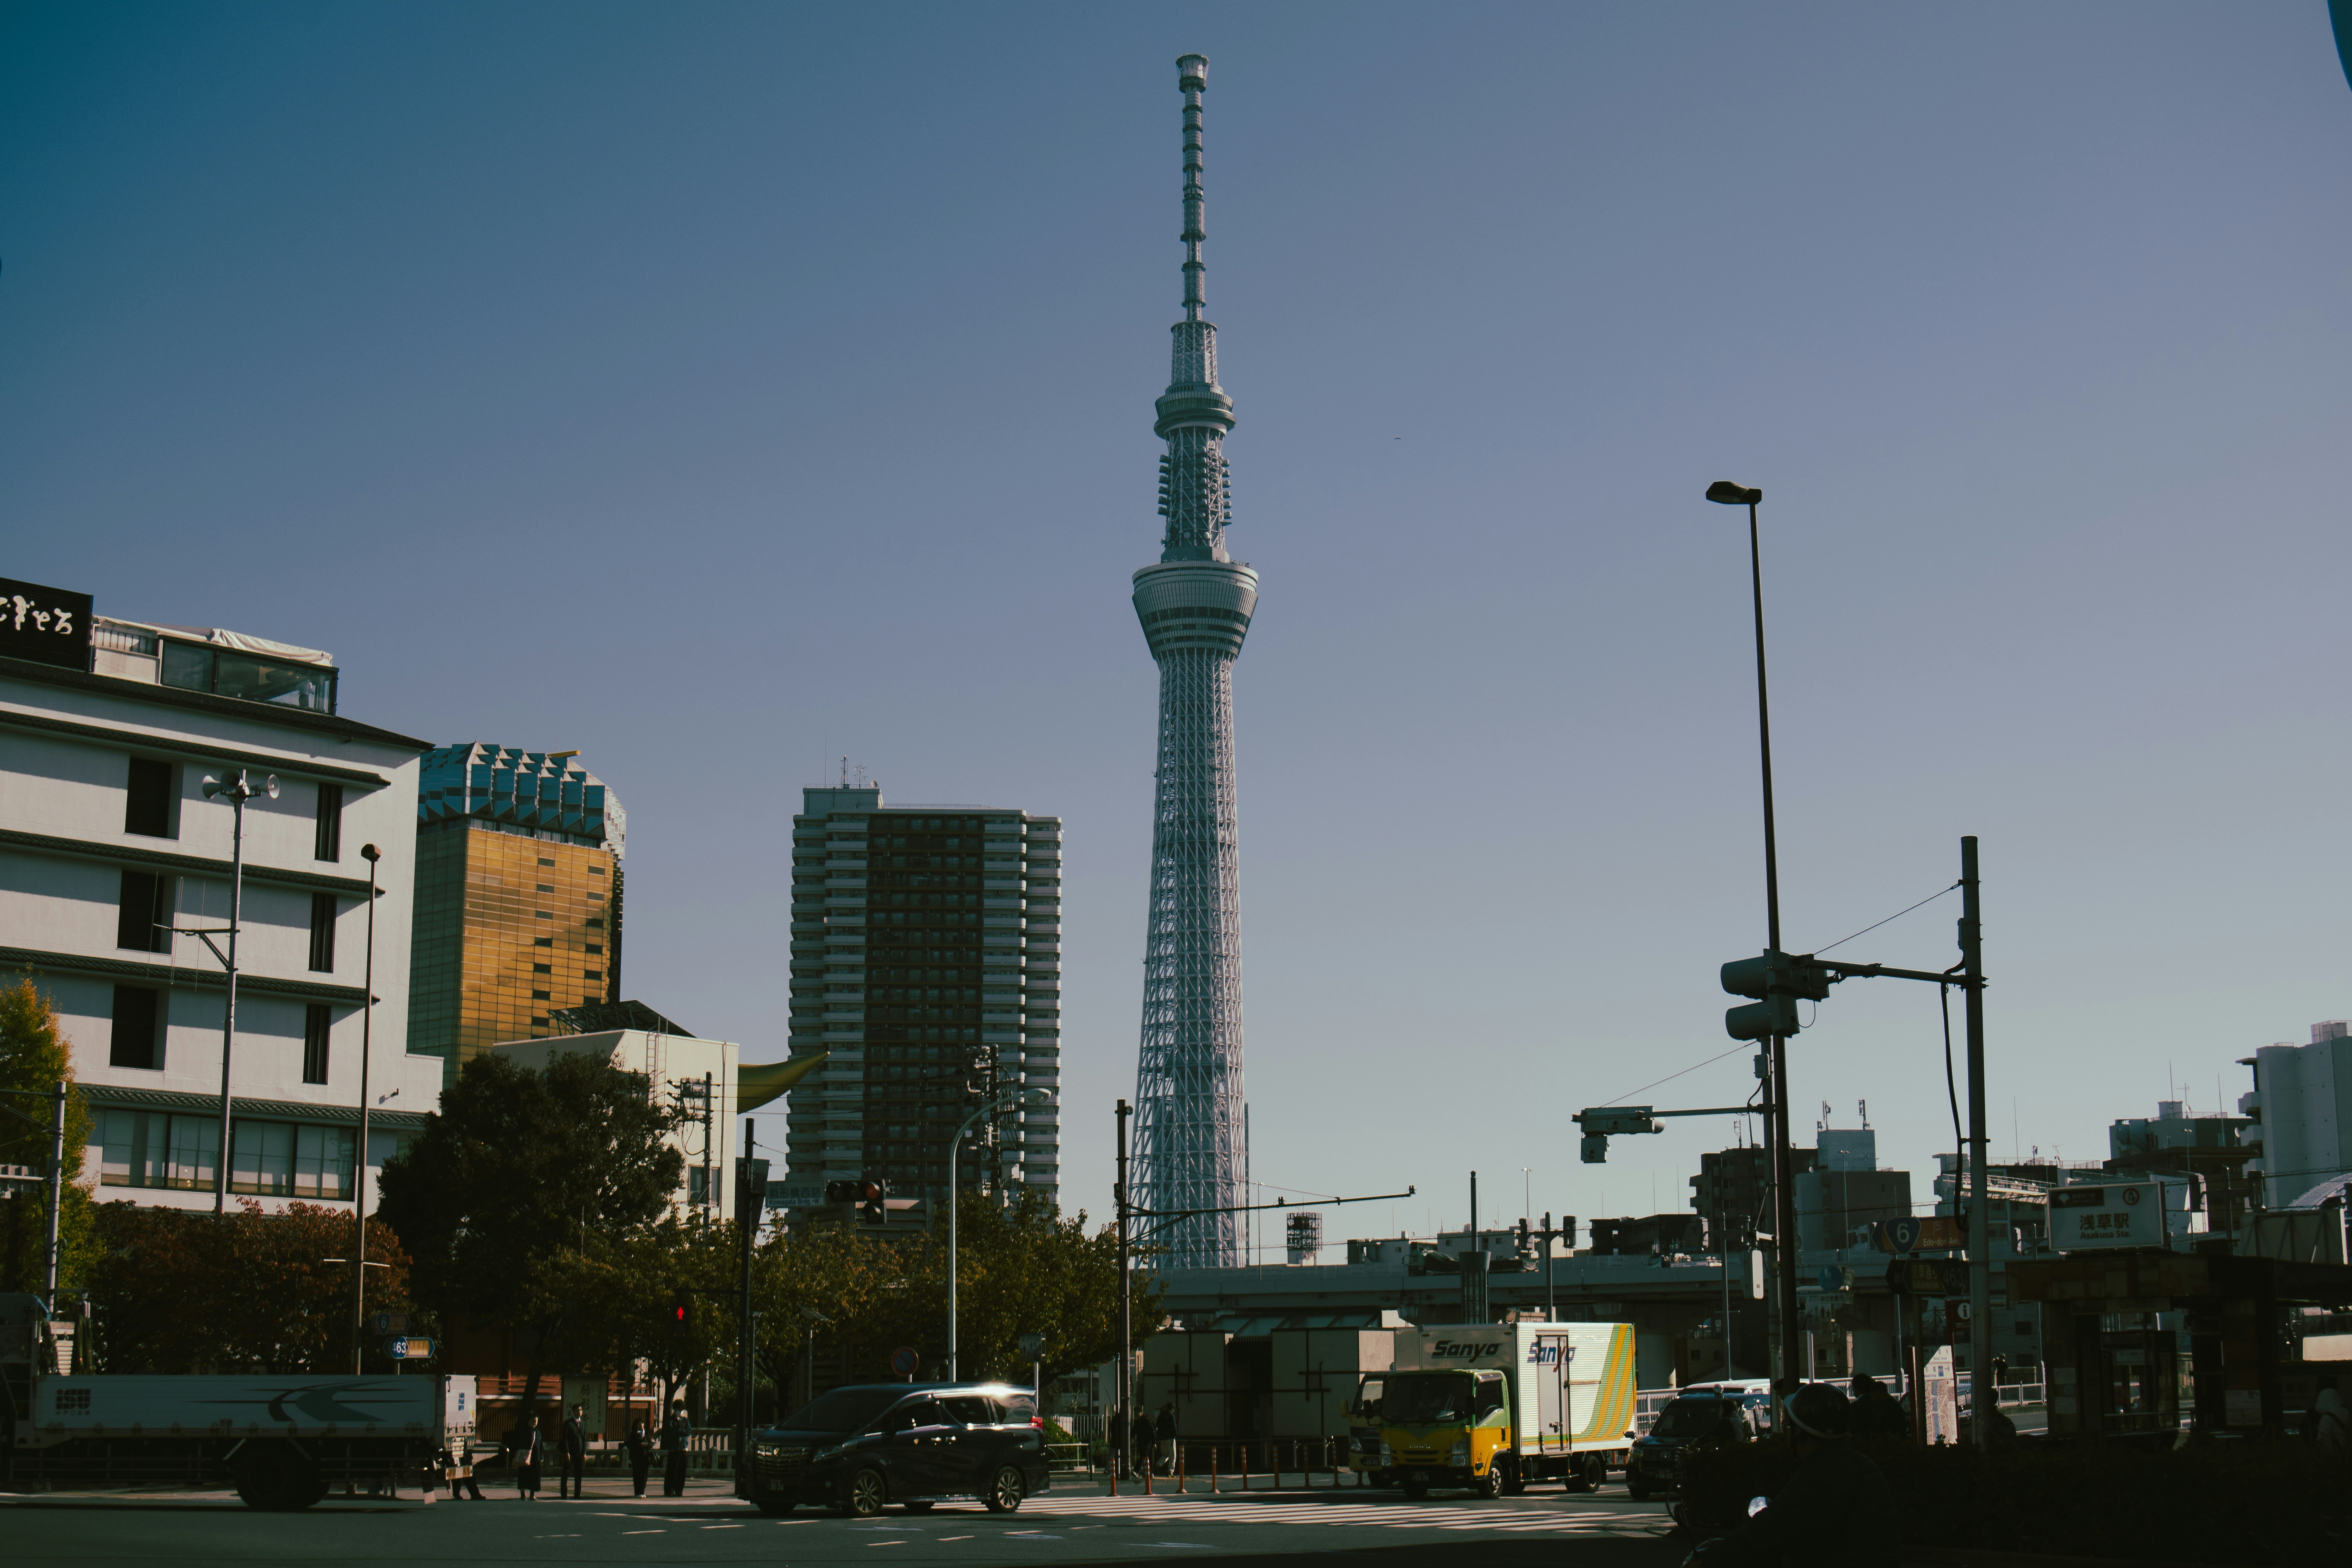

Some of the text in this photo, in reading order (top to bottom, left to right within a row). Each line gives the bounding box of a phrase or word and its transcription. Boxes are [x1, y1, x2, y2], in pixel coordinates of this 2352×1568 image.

[769, 1187, 821, 1198] 駒形橋西詰
[2080, 1213, 2129, 1230] 浅草駅
[1896, 1222, 1910, 1243] 6
[1923, 1237, 1947, 1246] Edo-dori
[1911, 1263, 1938, 1279] 浅草通り
[1943, 1267, 1964, 1287] 463
[381, 1317, 387, 1328] 6
[392, 1342, 407, 1353] 463
[1432, 1339, 1503, 1363] Sanyo
[1527, 1341, 1577, 1372] Sanyo
